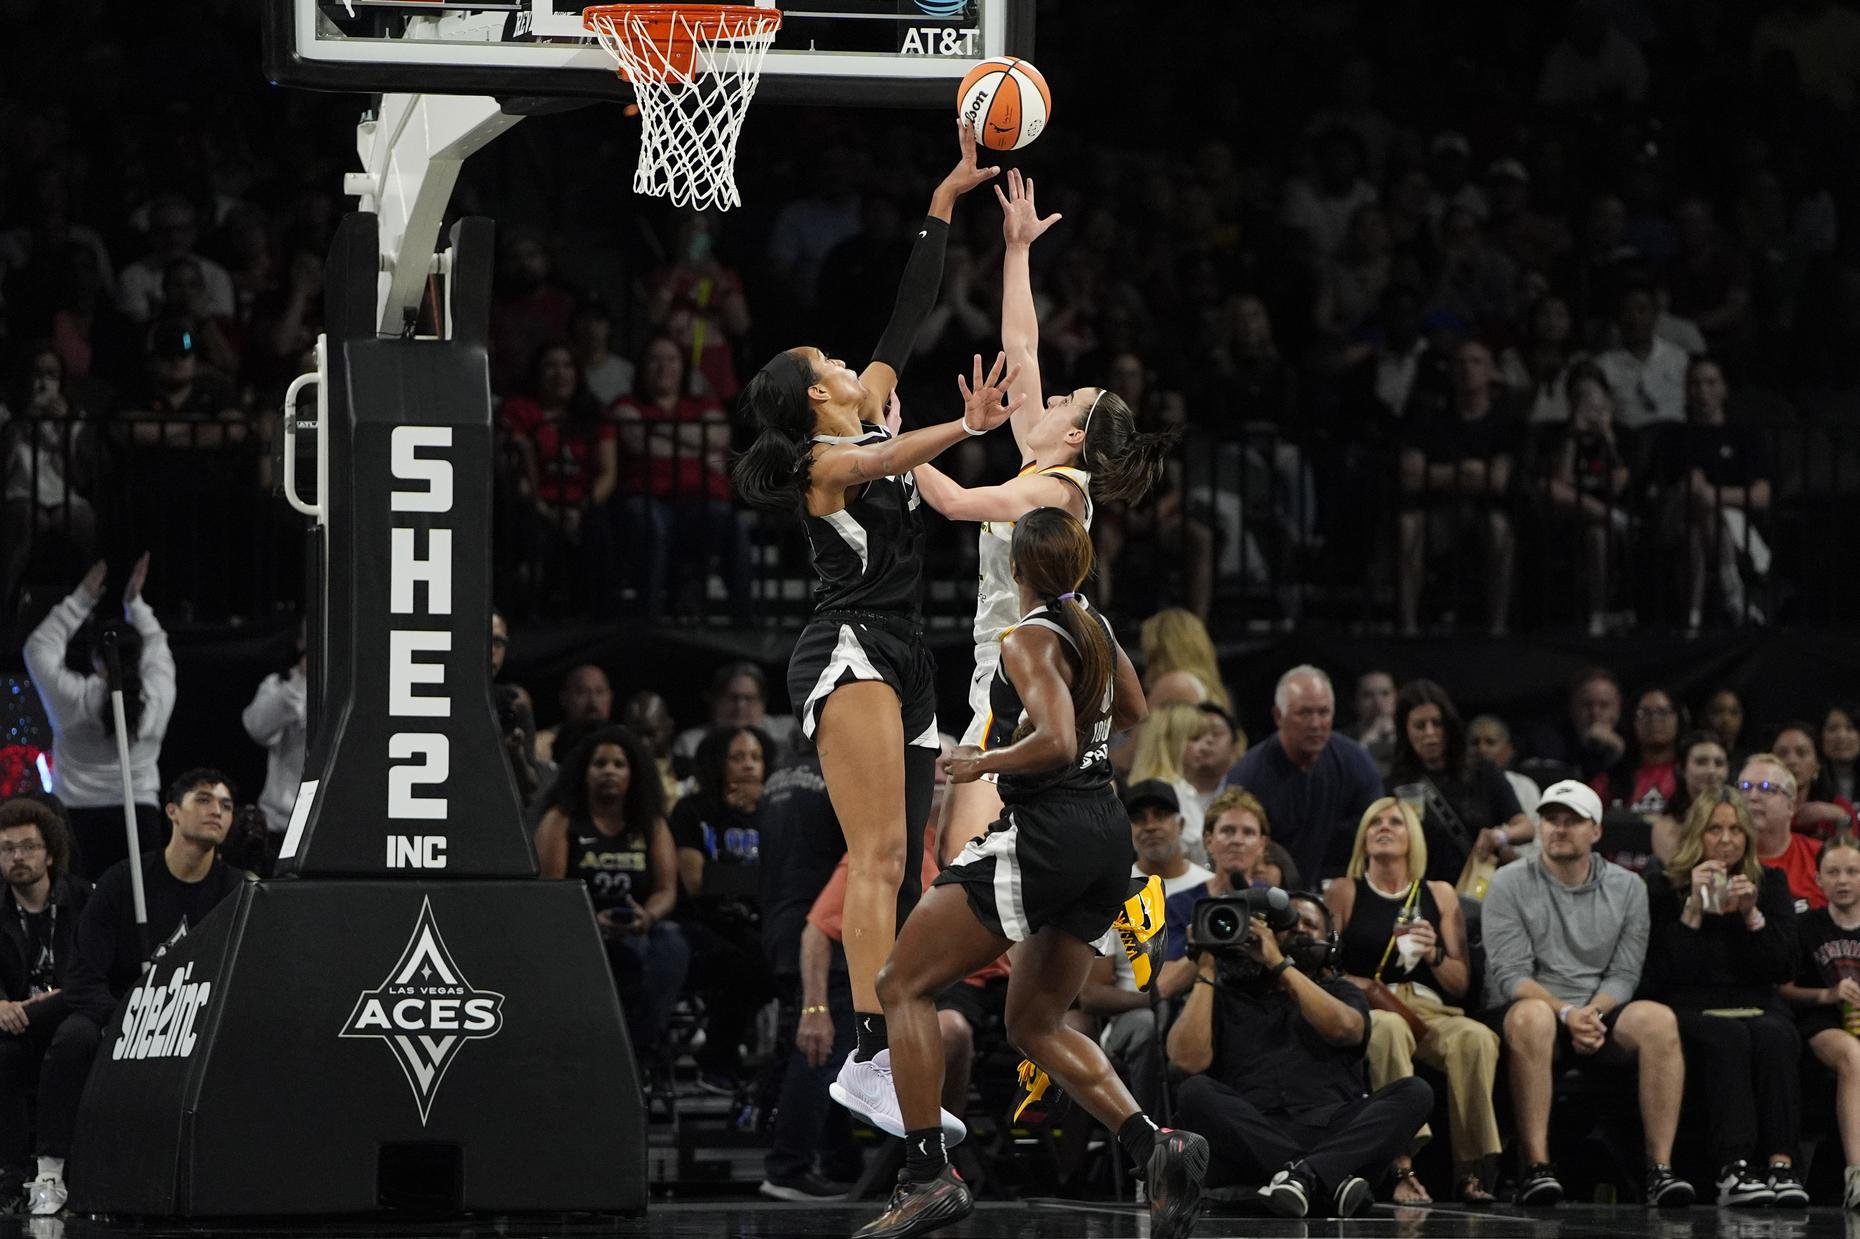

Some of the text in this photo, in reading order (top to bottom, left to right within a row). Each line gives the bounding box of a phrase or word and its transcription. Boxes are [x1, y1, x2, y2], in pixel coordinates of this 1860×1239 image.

[901, 27, 980, 56] AT&T
[386, 836, 447, 868] INC
[389, 987, 464, 995] LAS VEGAS
[112, 961, 211, 1060] she2inc
[354, 998, 496, 1031] ACES
